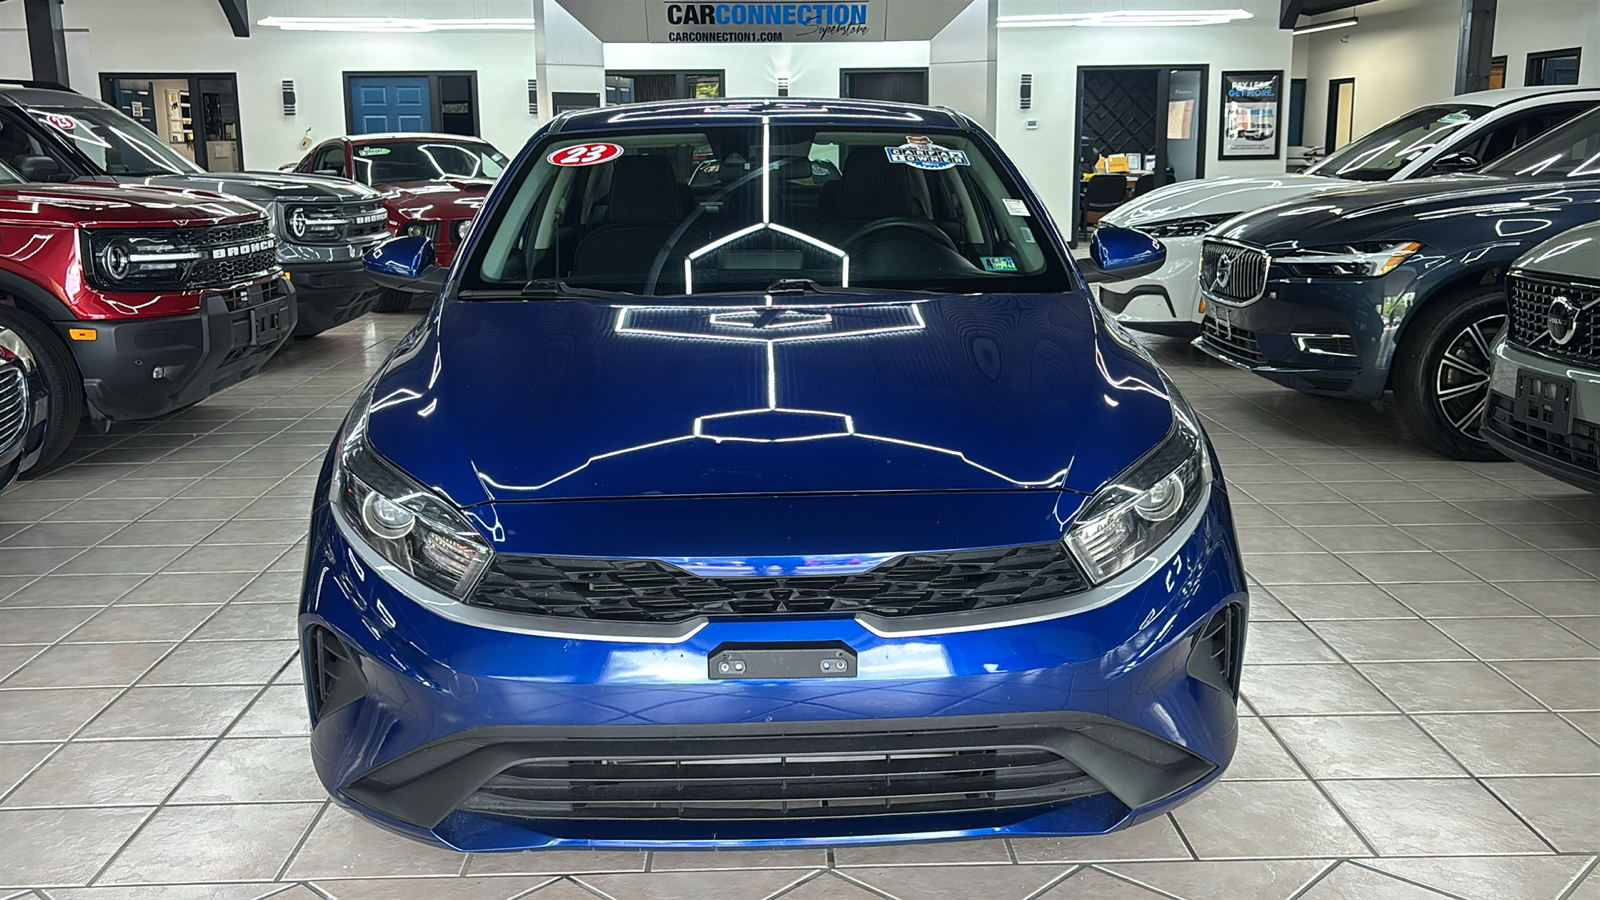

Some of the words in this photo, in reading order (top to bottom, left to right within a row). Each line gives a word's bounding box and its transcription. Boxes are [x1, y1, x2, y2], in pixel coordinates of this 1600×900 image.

[796, 15, 870, 40] Superstore
[669, 32, 783, 42] CARCONNECTION1.COM
[1228, 88, 1246, 97] GET
[560, 145, 608, 163] 23
[212, 239, 275, 259] BRONCO
